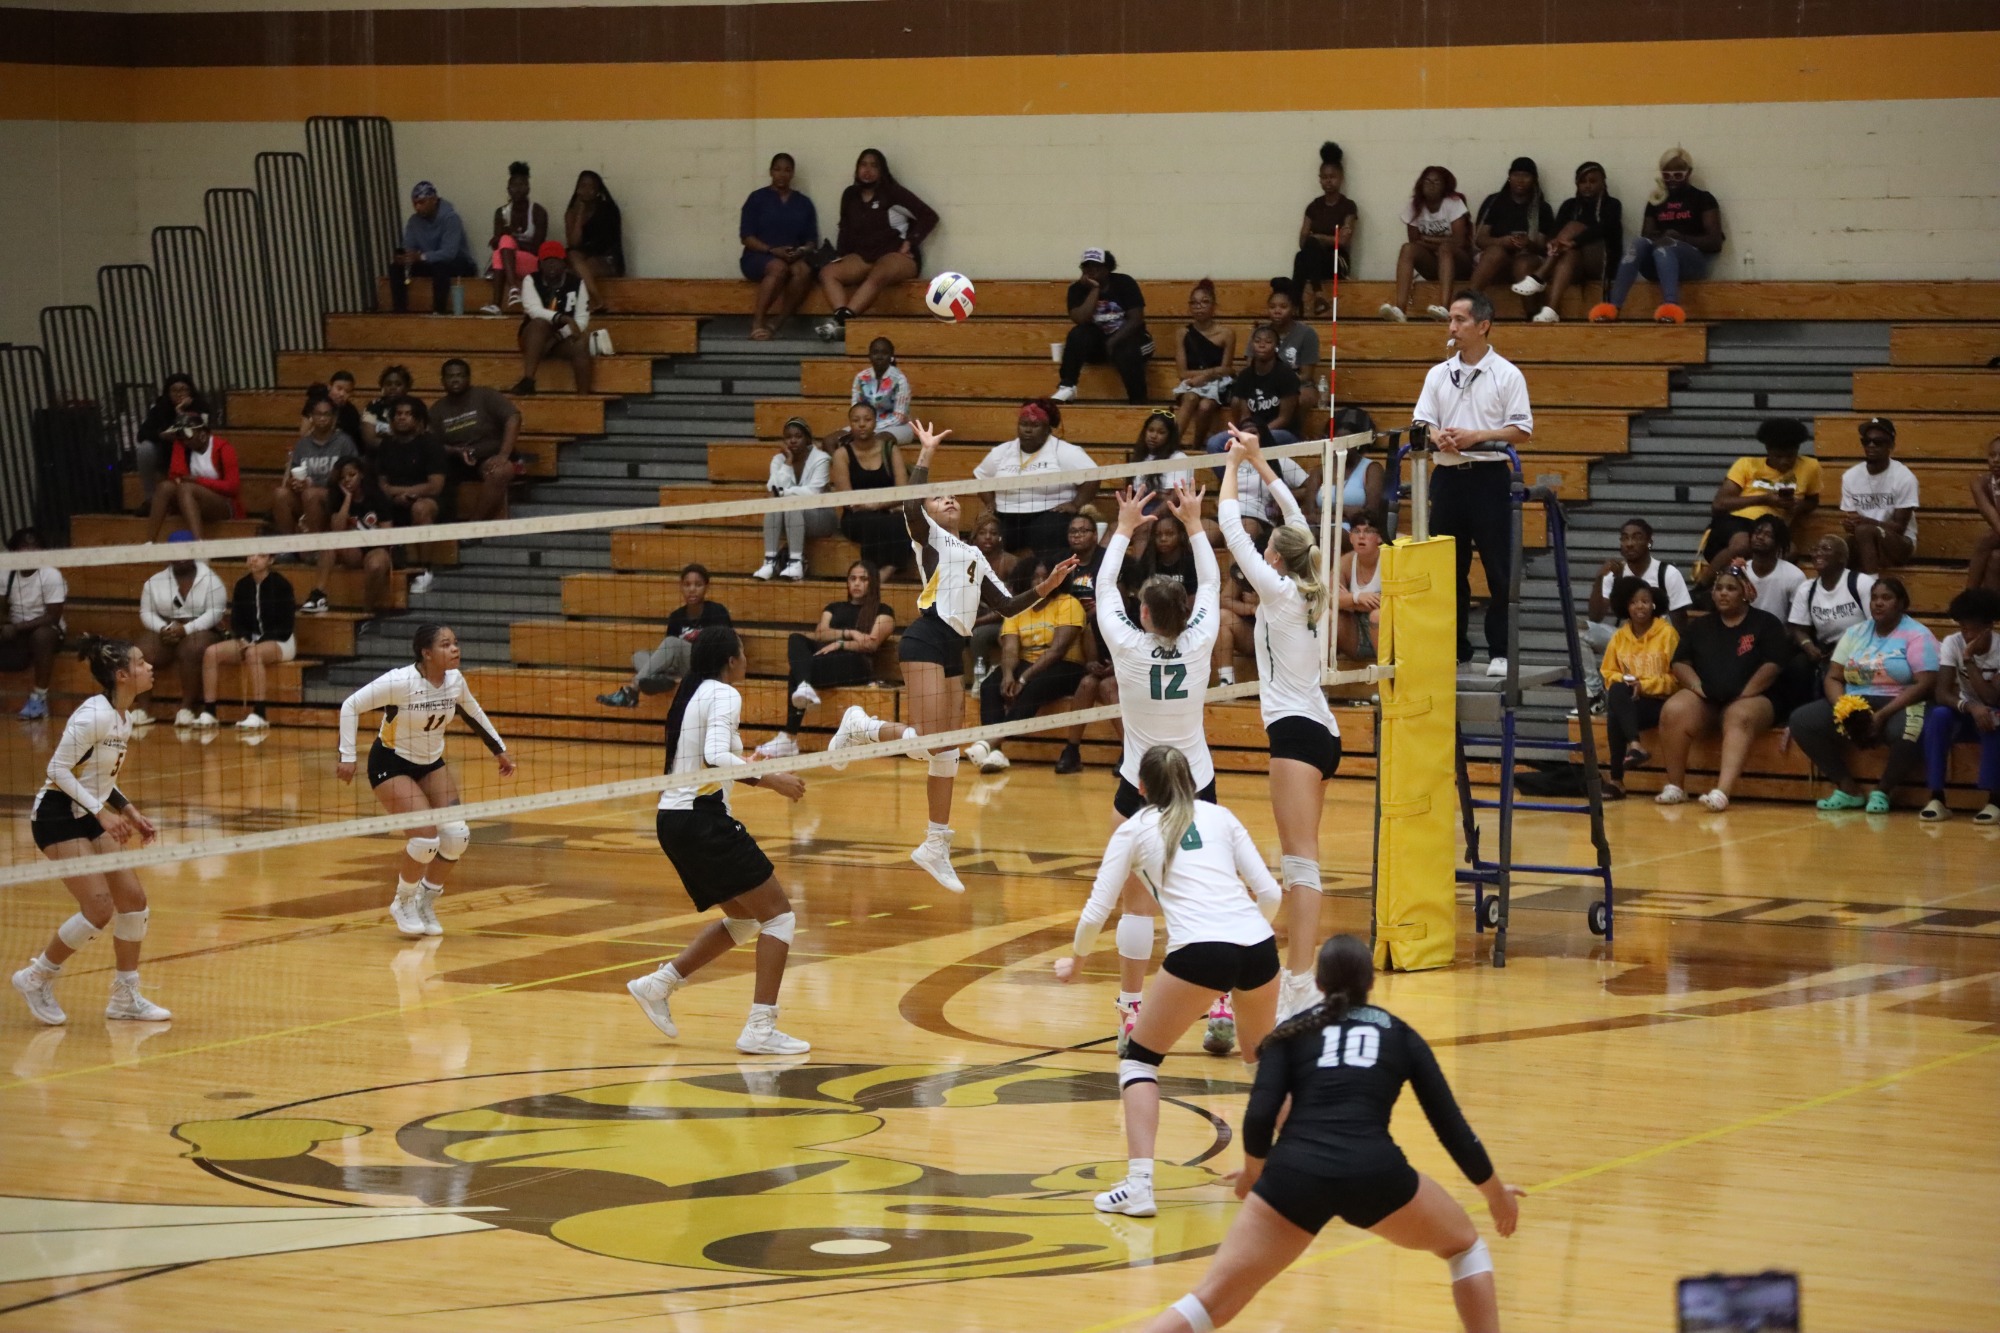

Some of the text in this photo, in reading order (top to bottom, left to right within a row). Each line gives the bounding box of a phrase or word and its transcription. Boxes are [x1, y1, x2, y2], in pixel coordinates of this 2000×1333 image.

[966, 560, 977, 584] 4
[1149, 664, 1188, 700] 12
[423, 714, 446, 732] 11
[110, 752, 124, 777] 5
[1317, 1025, 1380, 1068] 10
